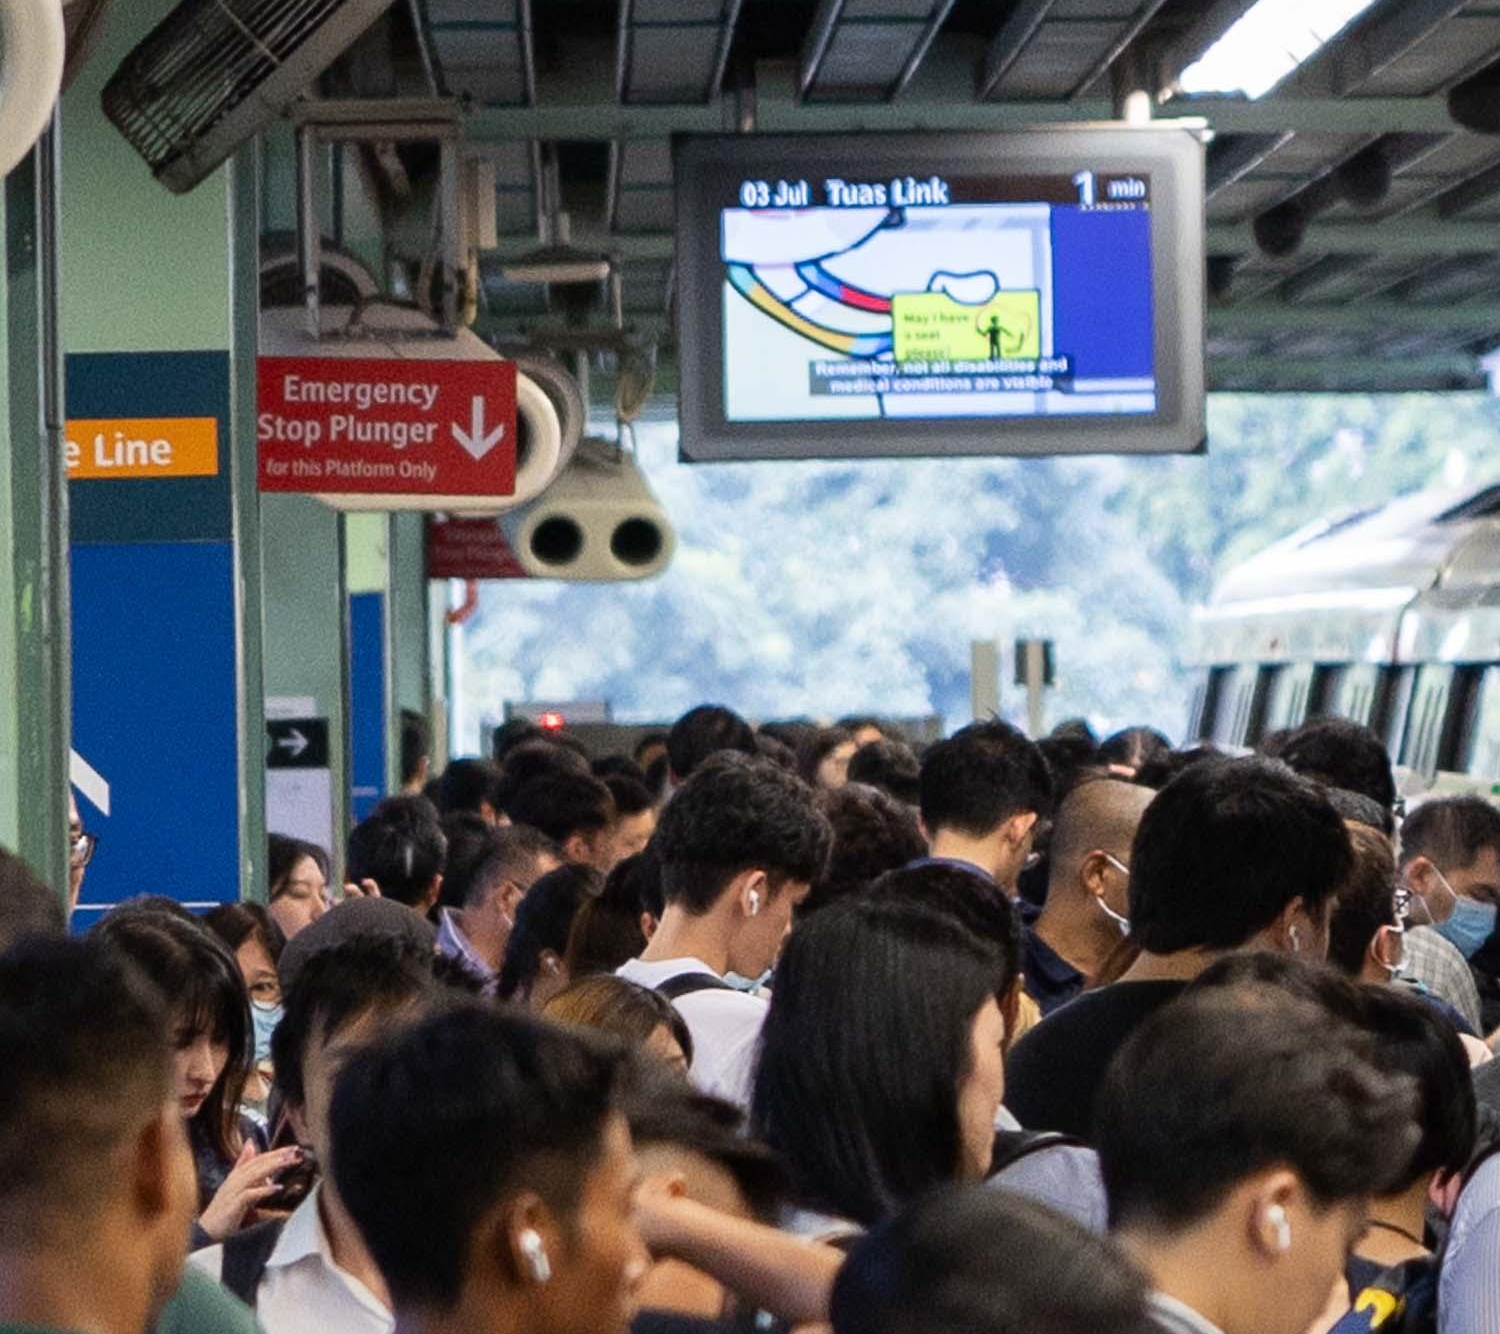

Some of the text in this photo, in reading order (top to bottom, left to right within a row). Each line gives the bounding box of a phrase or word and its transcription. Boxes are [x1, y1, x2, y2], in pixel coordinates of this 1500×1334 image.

[740, 169, 1146, 207] 03 Jul Tuas Link 1 min
[815, 354, 1067, 376] Remember, not all disabilities and
[283, 374, 440, 410] Emergency
[829, 373, 1054, 394] medical conditions are visible
[94, 431, 173, 468] Line
[258, 413, 439, 450] Stop Plunger
[266, 458, 437, 482] for this Platform Only
